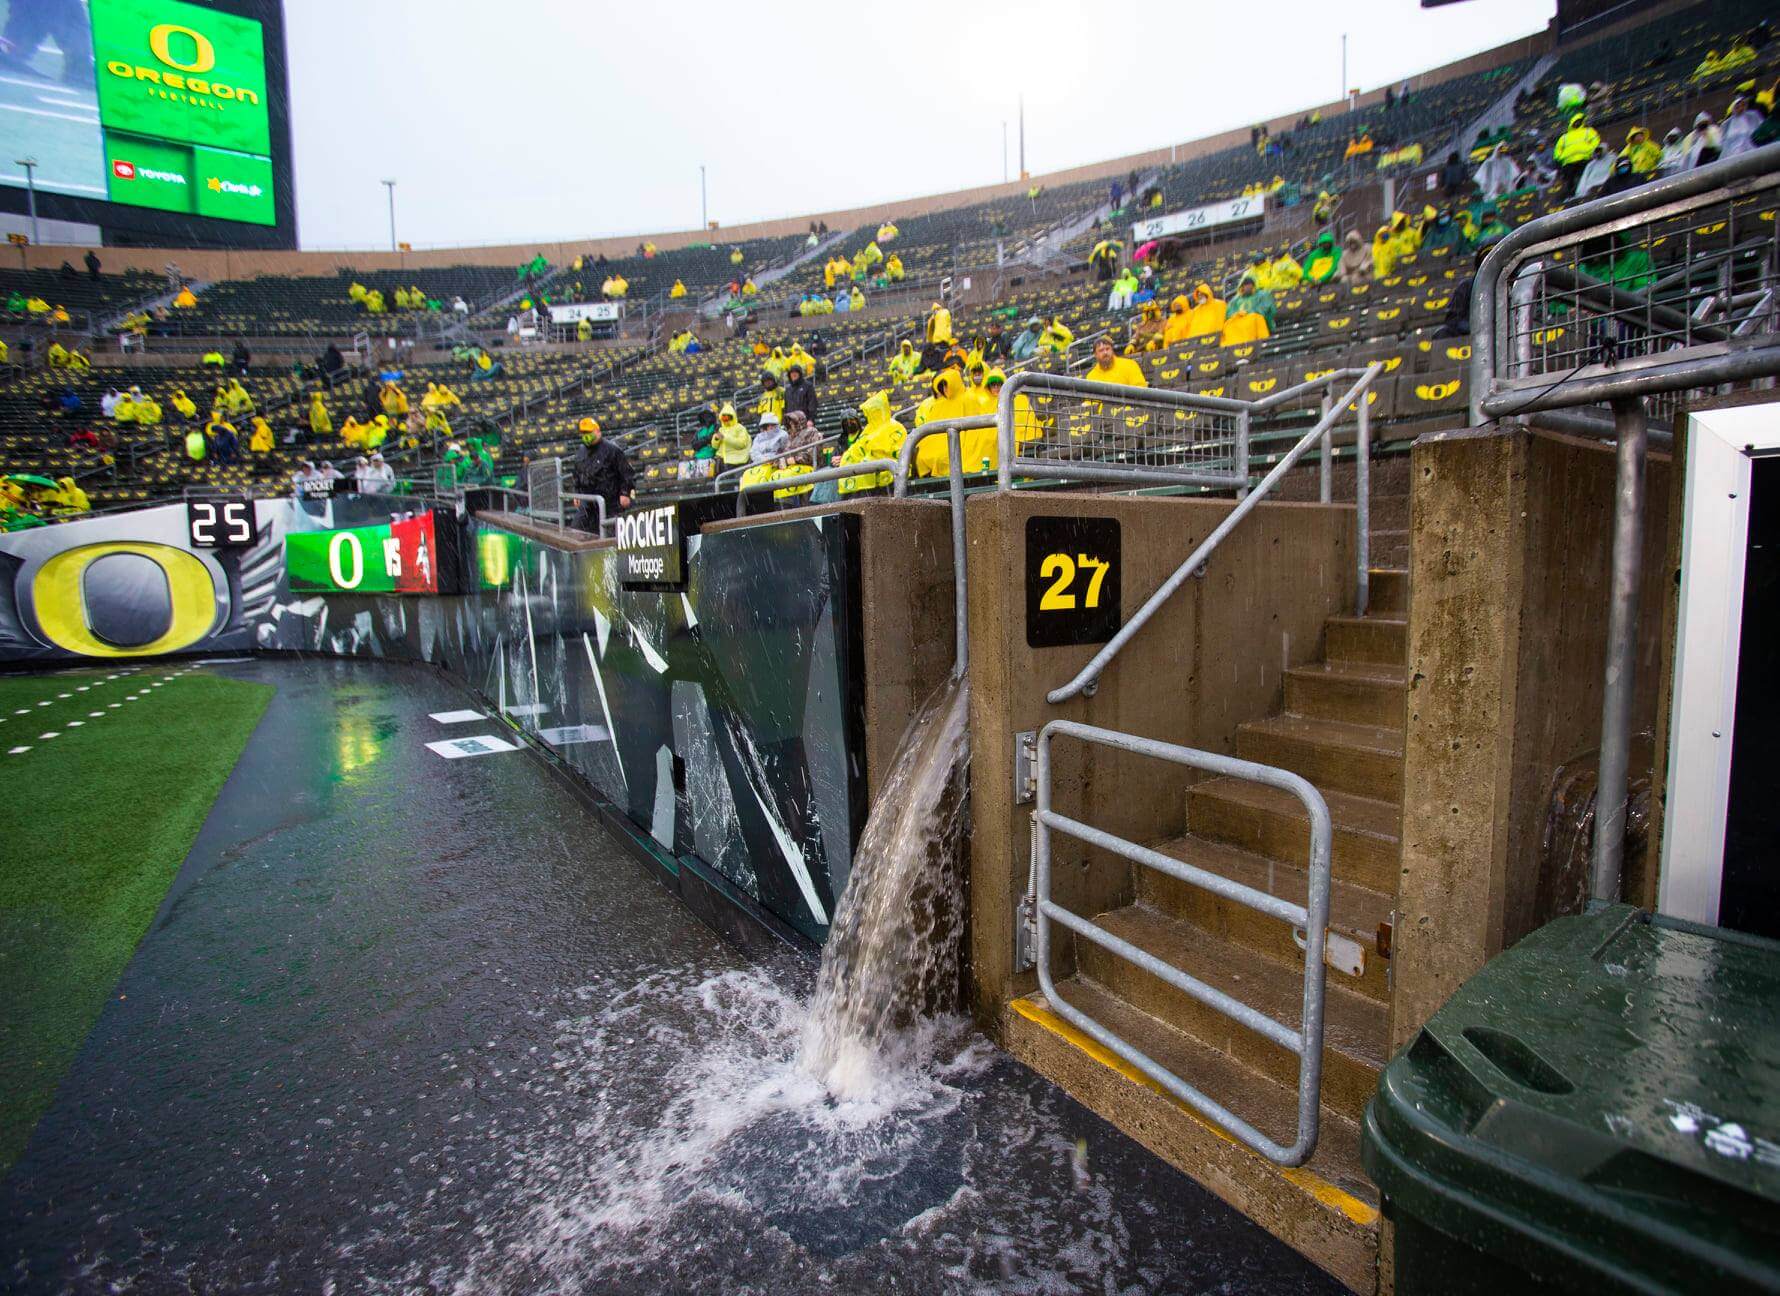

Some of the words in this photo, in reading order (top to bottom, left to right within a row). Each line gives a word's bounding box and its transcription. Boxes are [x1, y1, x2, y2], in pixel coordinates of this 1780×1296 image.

[107, 61, 259, 104] OREGON
[1146, 221, 1164, 236] 25
[1187, 211, 1206, 226] 26
[1231, 201, 1249, 216] 27
[568, 308, 582, 319] 24
[193, 503, 250, 542] 25
[617, 505, 676, 550] ROCKET
[628, 554, 664, 579] Mortgage
[1040, 552, 1110, 611] 27
